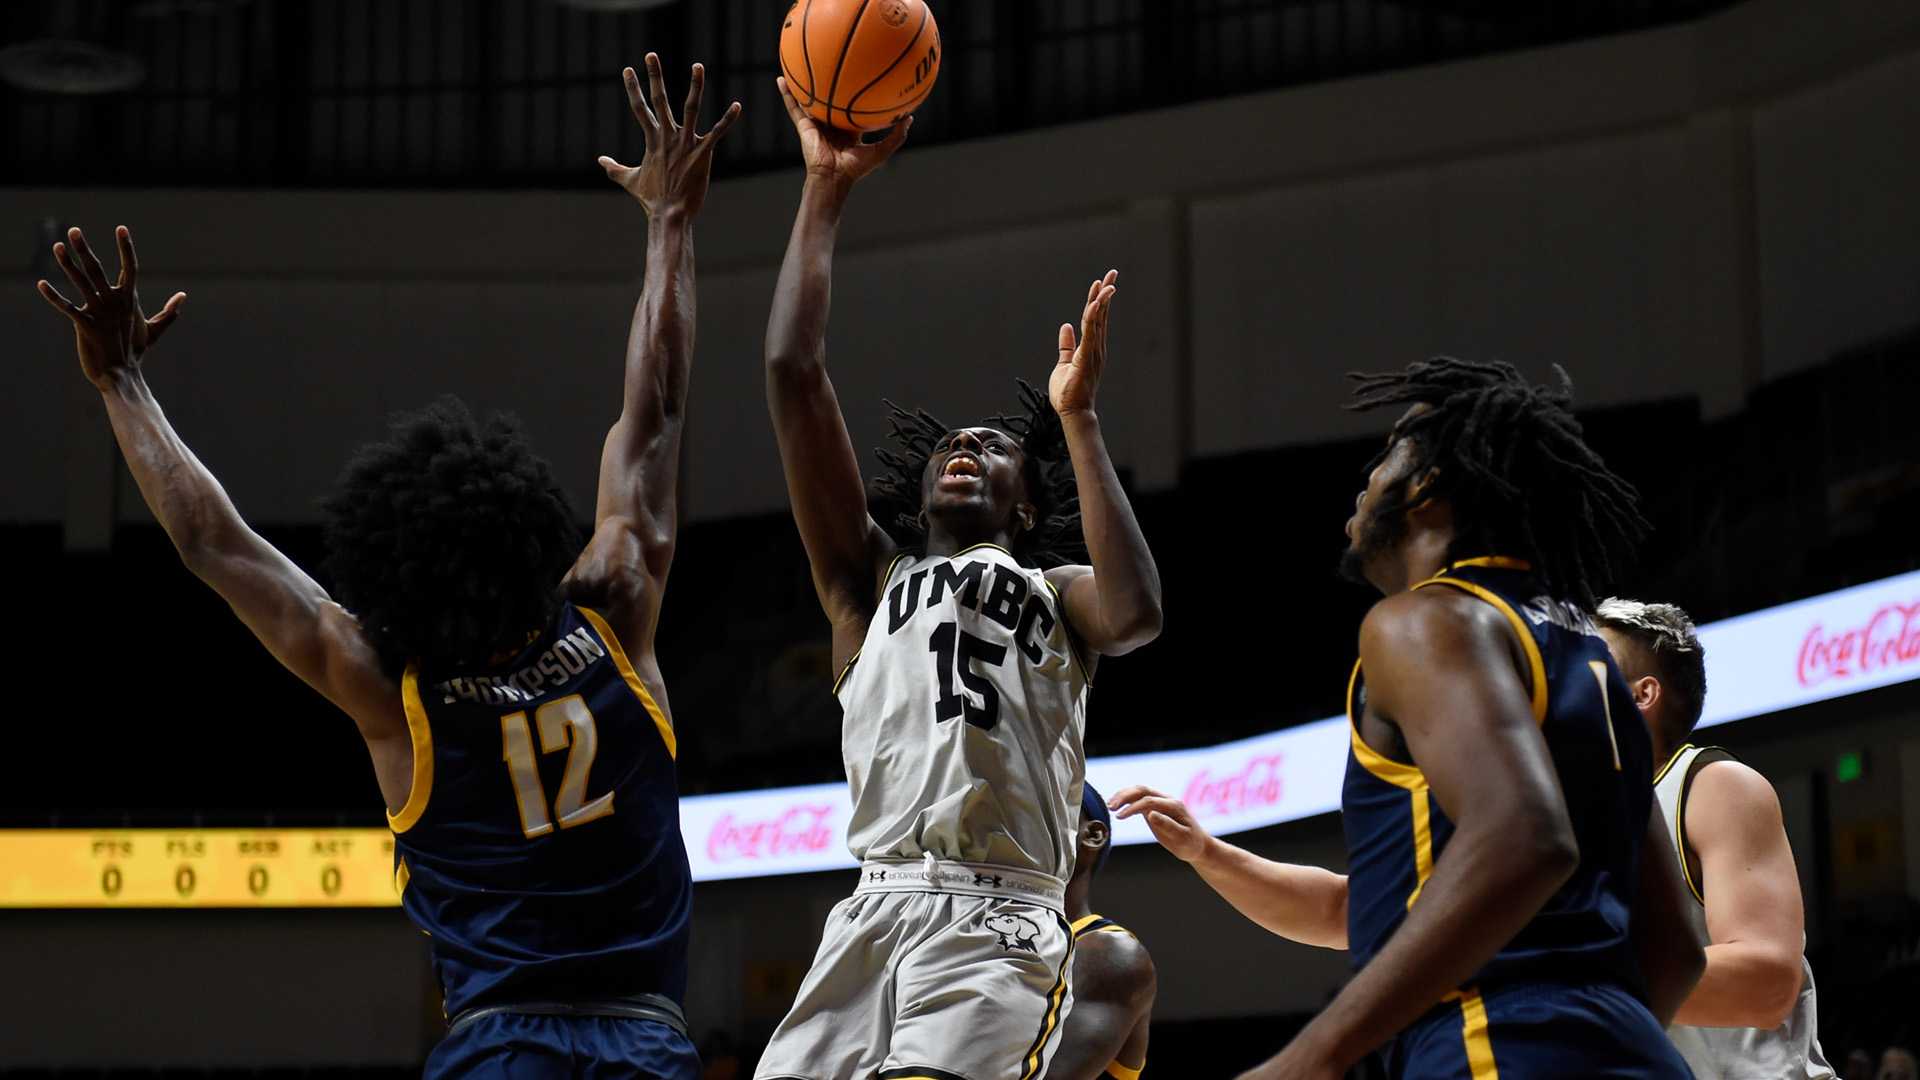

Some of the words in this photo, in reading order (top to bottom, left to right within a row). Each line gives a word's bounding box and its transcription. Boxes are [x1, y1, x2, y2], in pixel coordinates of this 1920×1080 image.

[887, 560, 1056, 666] UMBC
[929, 621, 1008, 732] 15
[500, 693, 615, 840] 12
[102, 864, 123, 897] 0
[175, 864, 197, 897] 0
[248, 864, 270, 897] 0
[321, 864, 342, 897] 0
